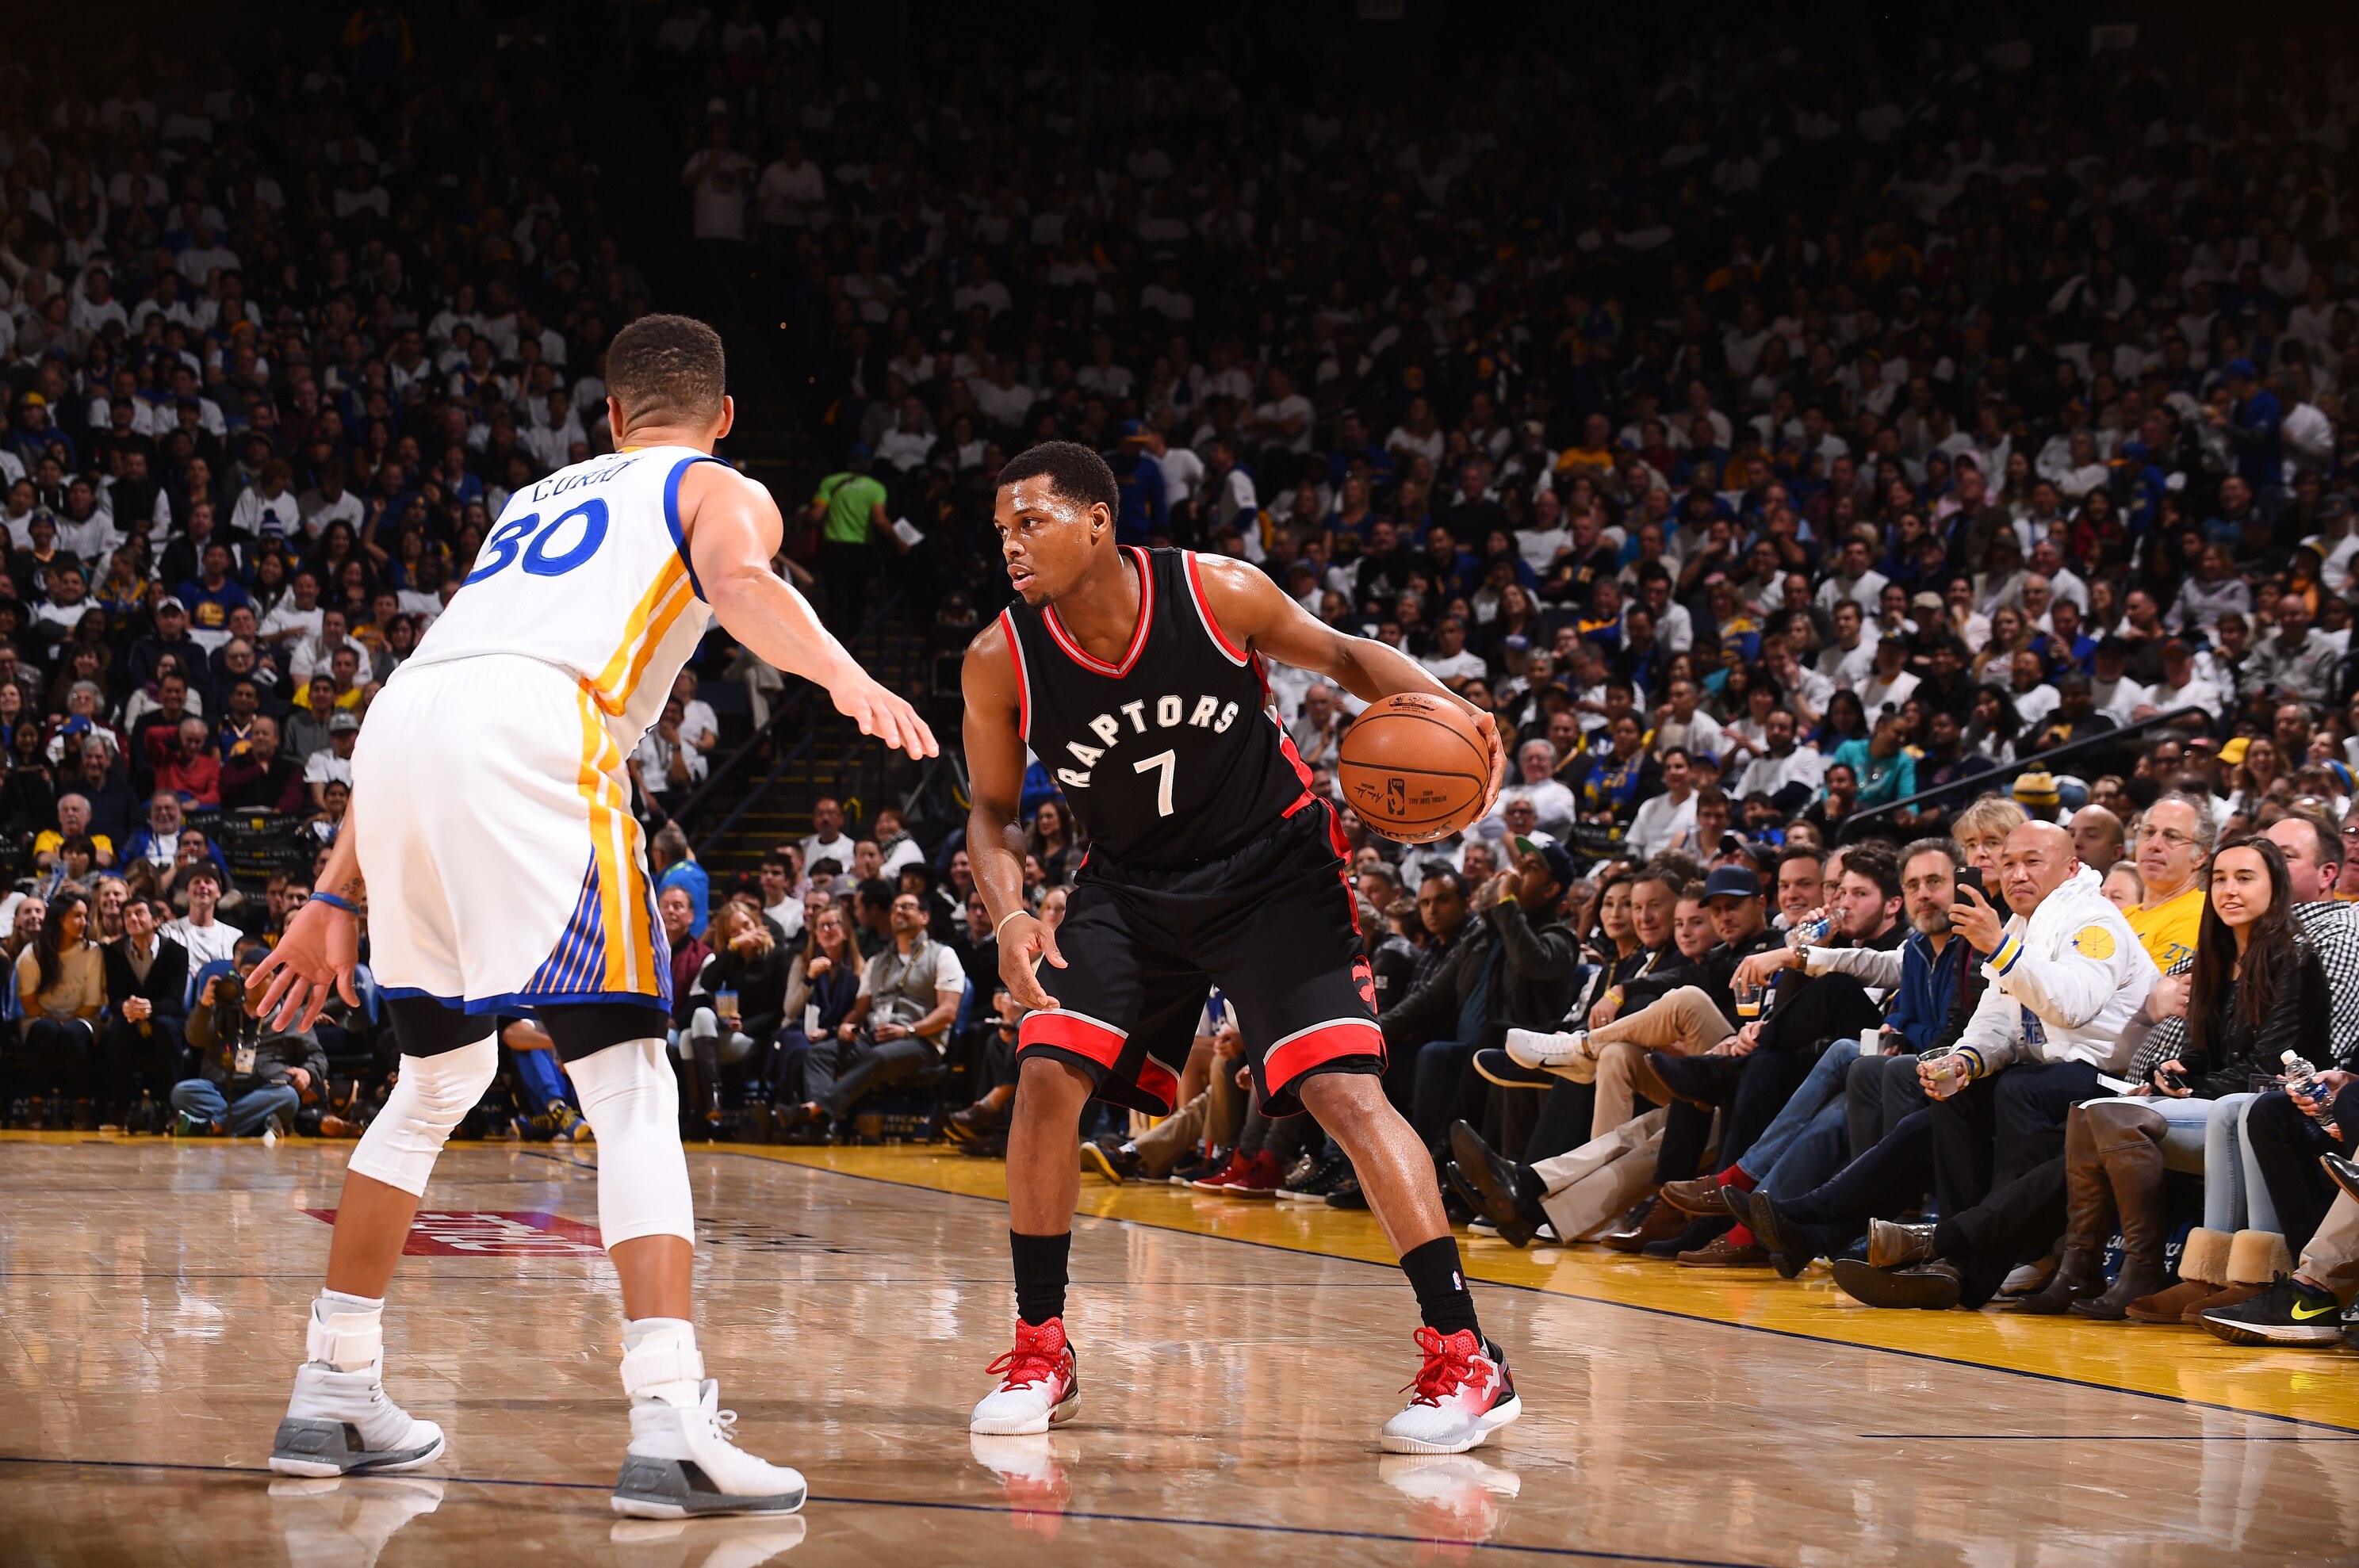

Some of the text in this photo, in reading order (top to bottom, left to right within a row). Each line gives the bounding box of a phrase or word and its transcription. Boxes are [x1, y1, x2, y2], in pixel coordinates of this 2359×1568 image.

[531, 457, 645, 503] CURRY
[461, 498, 609, 576] 30
[1057, 694, 1239, 788] RAPTORS
[1132, 748, 1176, 818] 7
